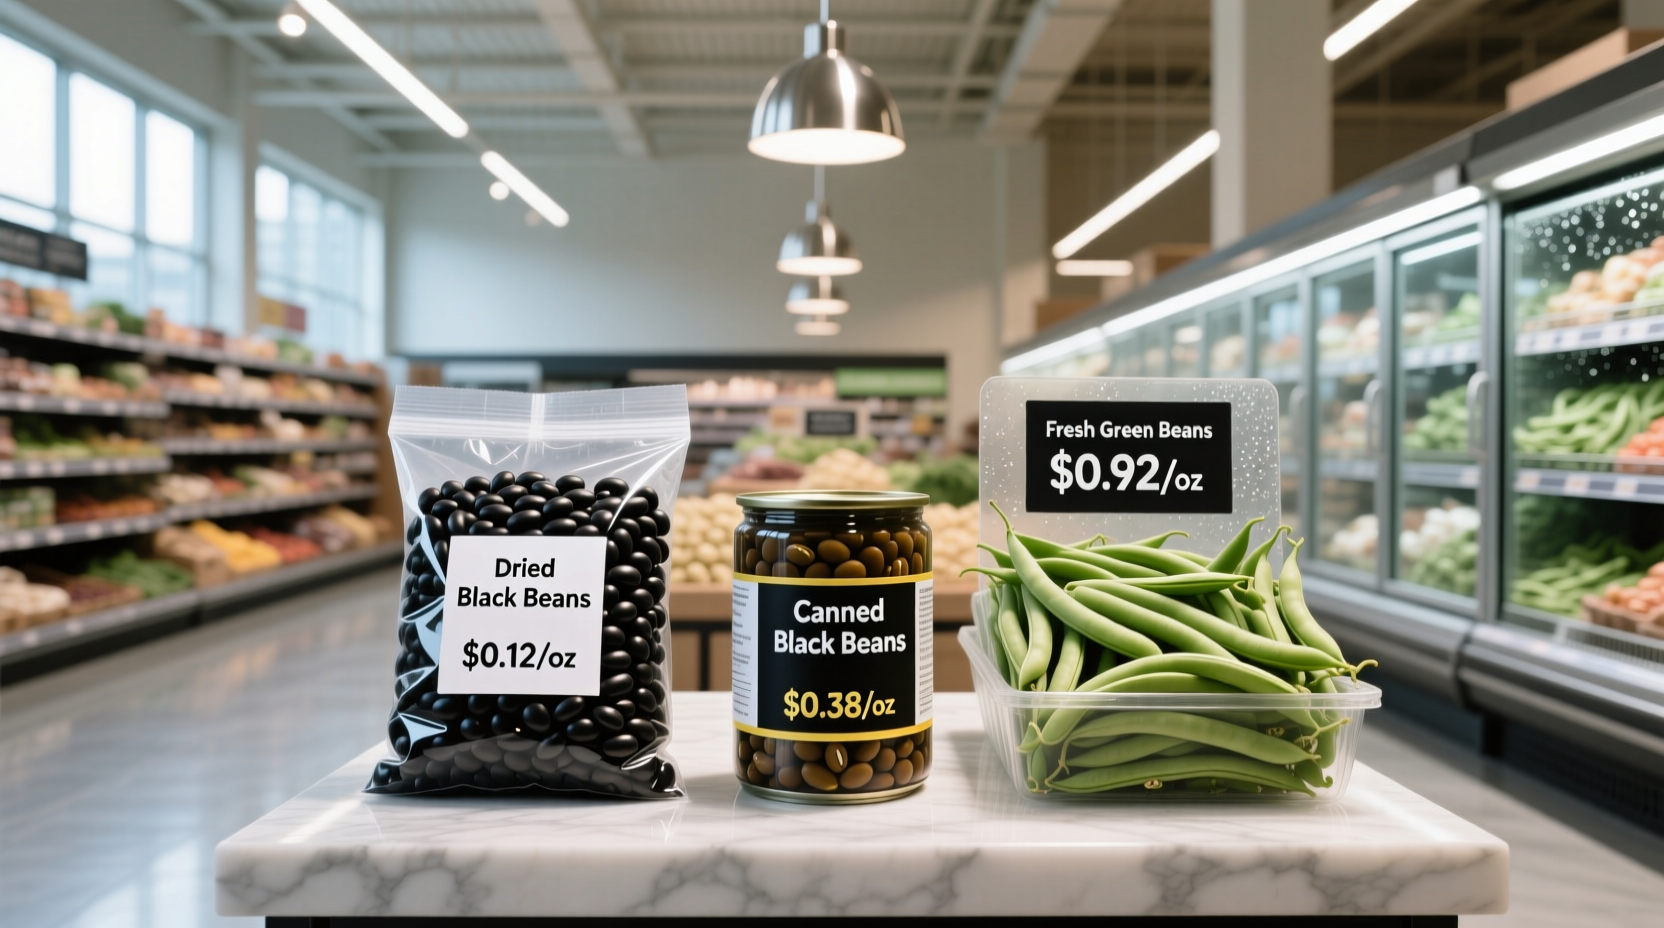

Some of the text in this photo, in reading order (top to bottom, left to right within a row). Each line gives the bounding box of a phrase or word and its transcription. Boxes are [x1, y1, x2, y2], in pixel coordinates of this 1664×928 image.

[1046, 419, 1213, 439] Fresh Green Beans
[1050, 448, 1204, 496] $0.92/oz
[494, 557, 556, 578] Dried
[457, 586, 591, 609] Black Beans
[793, 597, 885, 624] Canned
[462, 638, 577, 672] $0.12/oz
[774, 629, 907, 655] Black Beans
[783, 687, 896, 722] $0.38/oz
